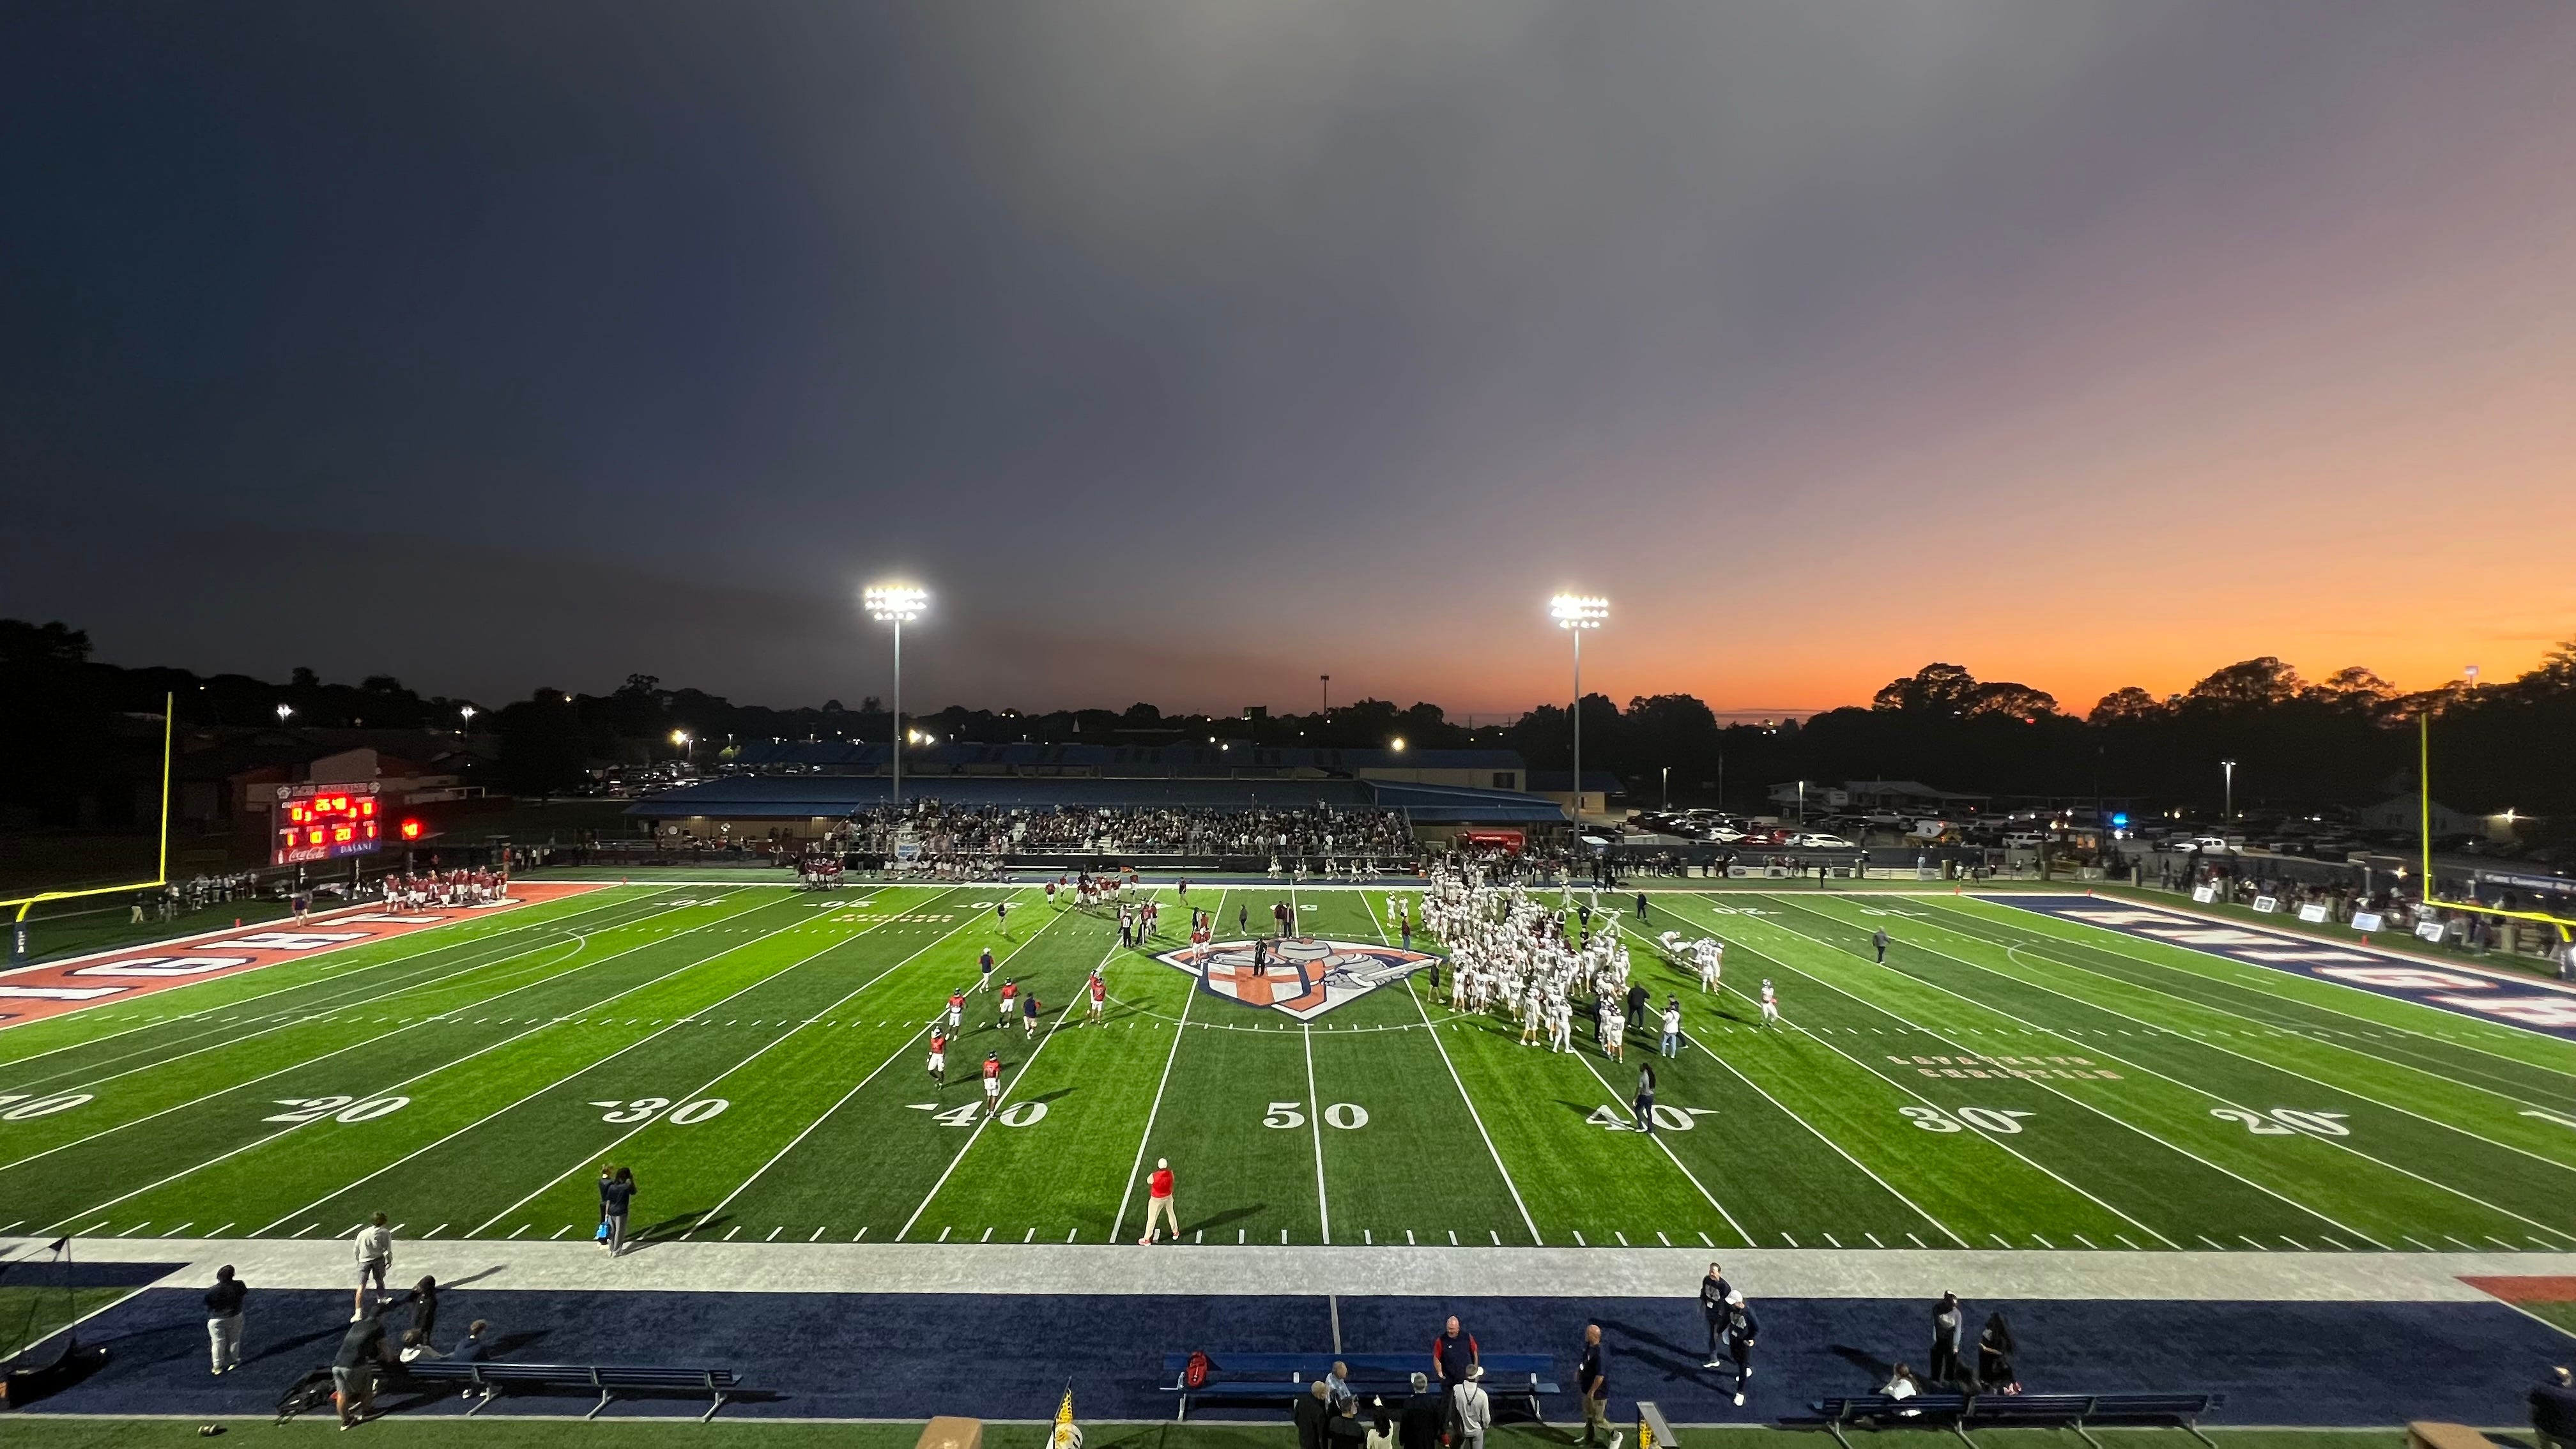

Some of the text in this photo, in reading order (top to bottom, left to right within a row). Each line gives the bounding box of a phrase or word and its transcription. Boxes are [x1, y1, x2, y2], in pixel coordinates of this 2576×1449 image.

[341, 843, 372, 854] DASANI
[17, 930, 26, 953] LCA
[261, 1095, 411, 1123] 20
[602, 1097, 730, 1125] 30
[932, 1100, 1048, 1127] 40
[1262, 1101, 1369, 1130] 50
[1586, 1104, 1694, 1131] 40
[1898, 1106, 2023, 1133] 30
[2210, 1108, 2350, 1136] 20
